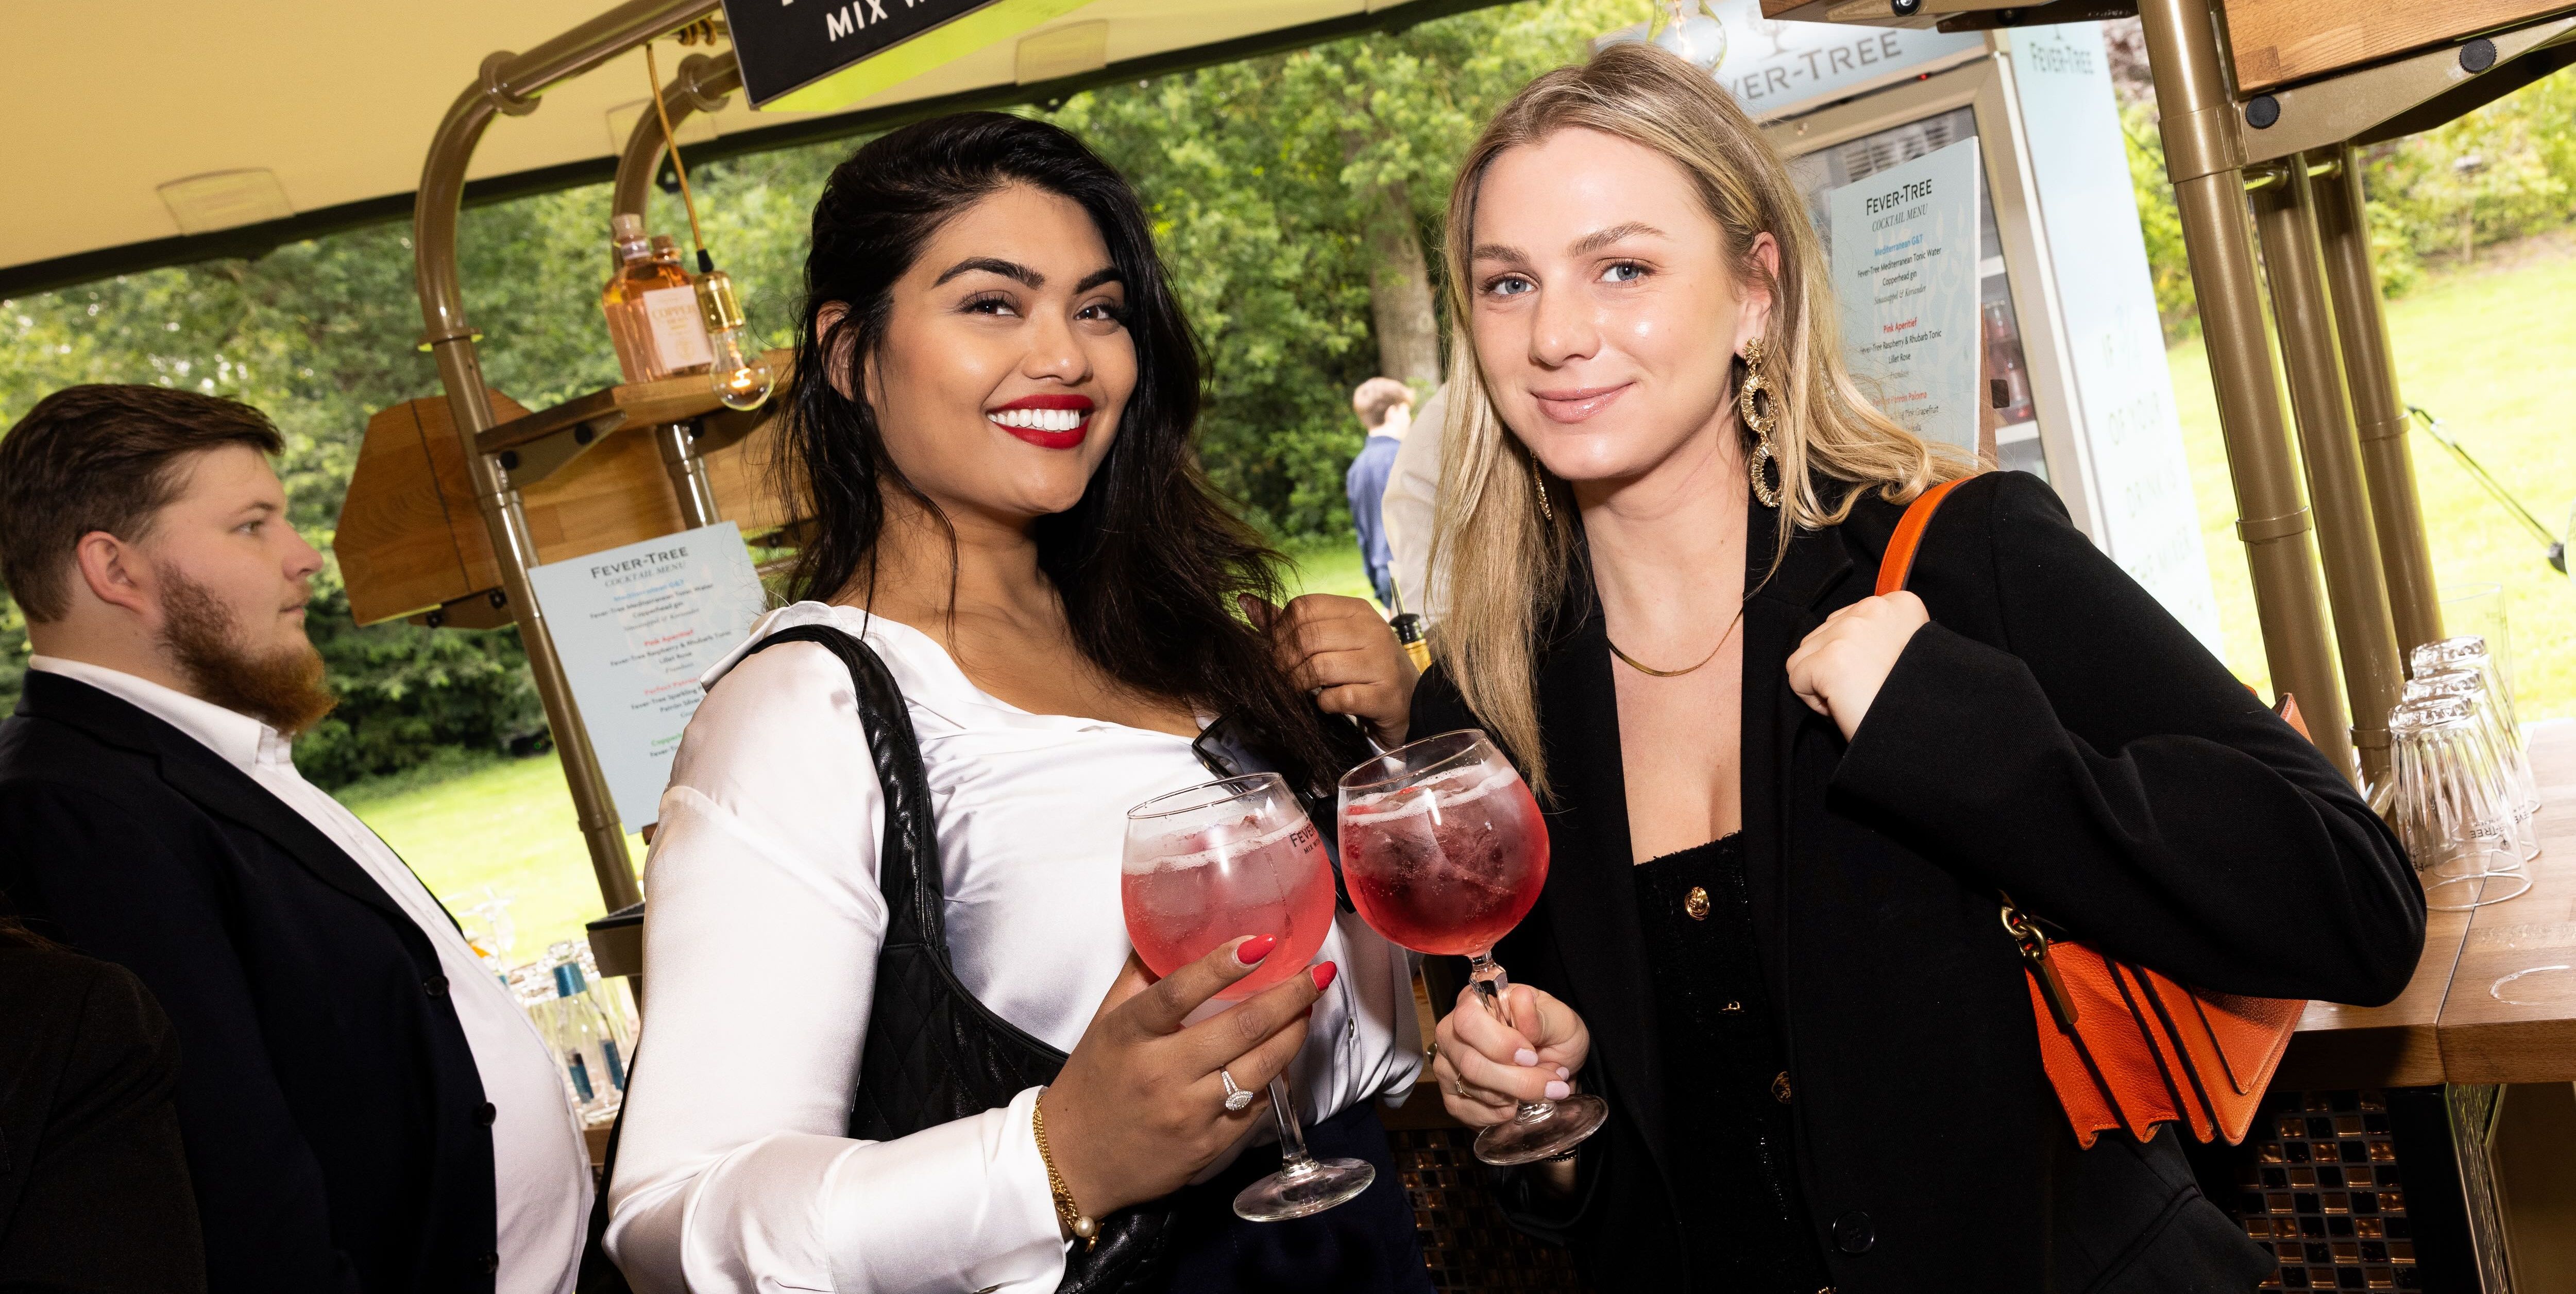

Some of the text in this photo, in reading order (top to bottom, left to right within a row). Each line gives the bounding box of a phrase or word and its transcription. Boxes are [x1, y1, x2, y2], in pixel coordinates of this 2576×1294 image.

[826, 0, 888, 42] MIX
[1866, 179, 1932, 215] FEVER-TREE
[1872, 203, 1928, 232] COCKTAIL MENU
[1874, 233, 1923, 257] Mediterranean G&T
[1857, 247, 1942, 278] Fever-Tree Mediterranean Tonic Water
[1882, 270, 1910, 287] Copperhead
[1883, 316, 1918, 334] Pink Aperitief
[1883, 339, 1904, 350] Raspberry
[1905, 336, 1909, 344] &
[1909, 331, 1928, 344] Rhubarb
[1929, 329, 1942, 340] Tonic
[1888, 352, 1911, 364] Lillet Rose
[591, 546, 689, 579] FEVER-TREE
[604, 561, 687, 587] COCKTAIL MENU
[1303, 844, 1314, 854] MIX
